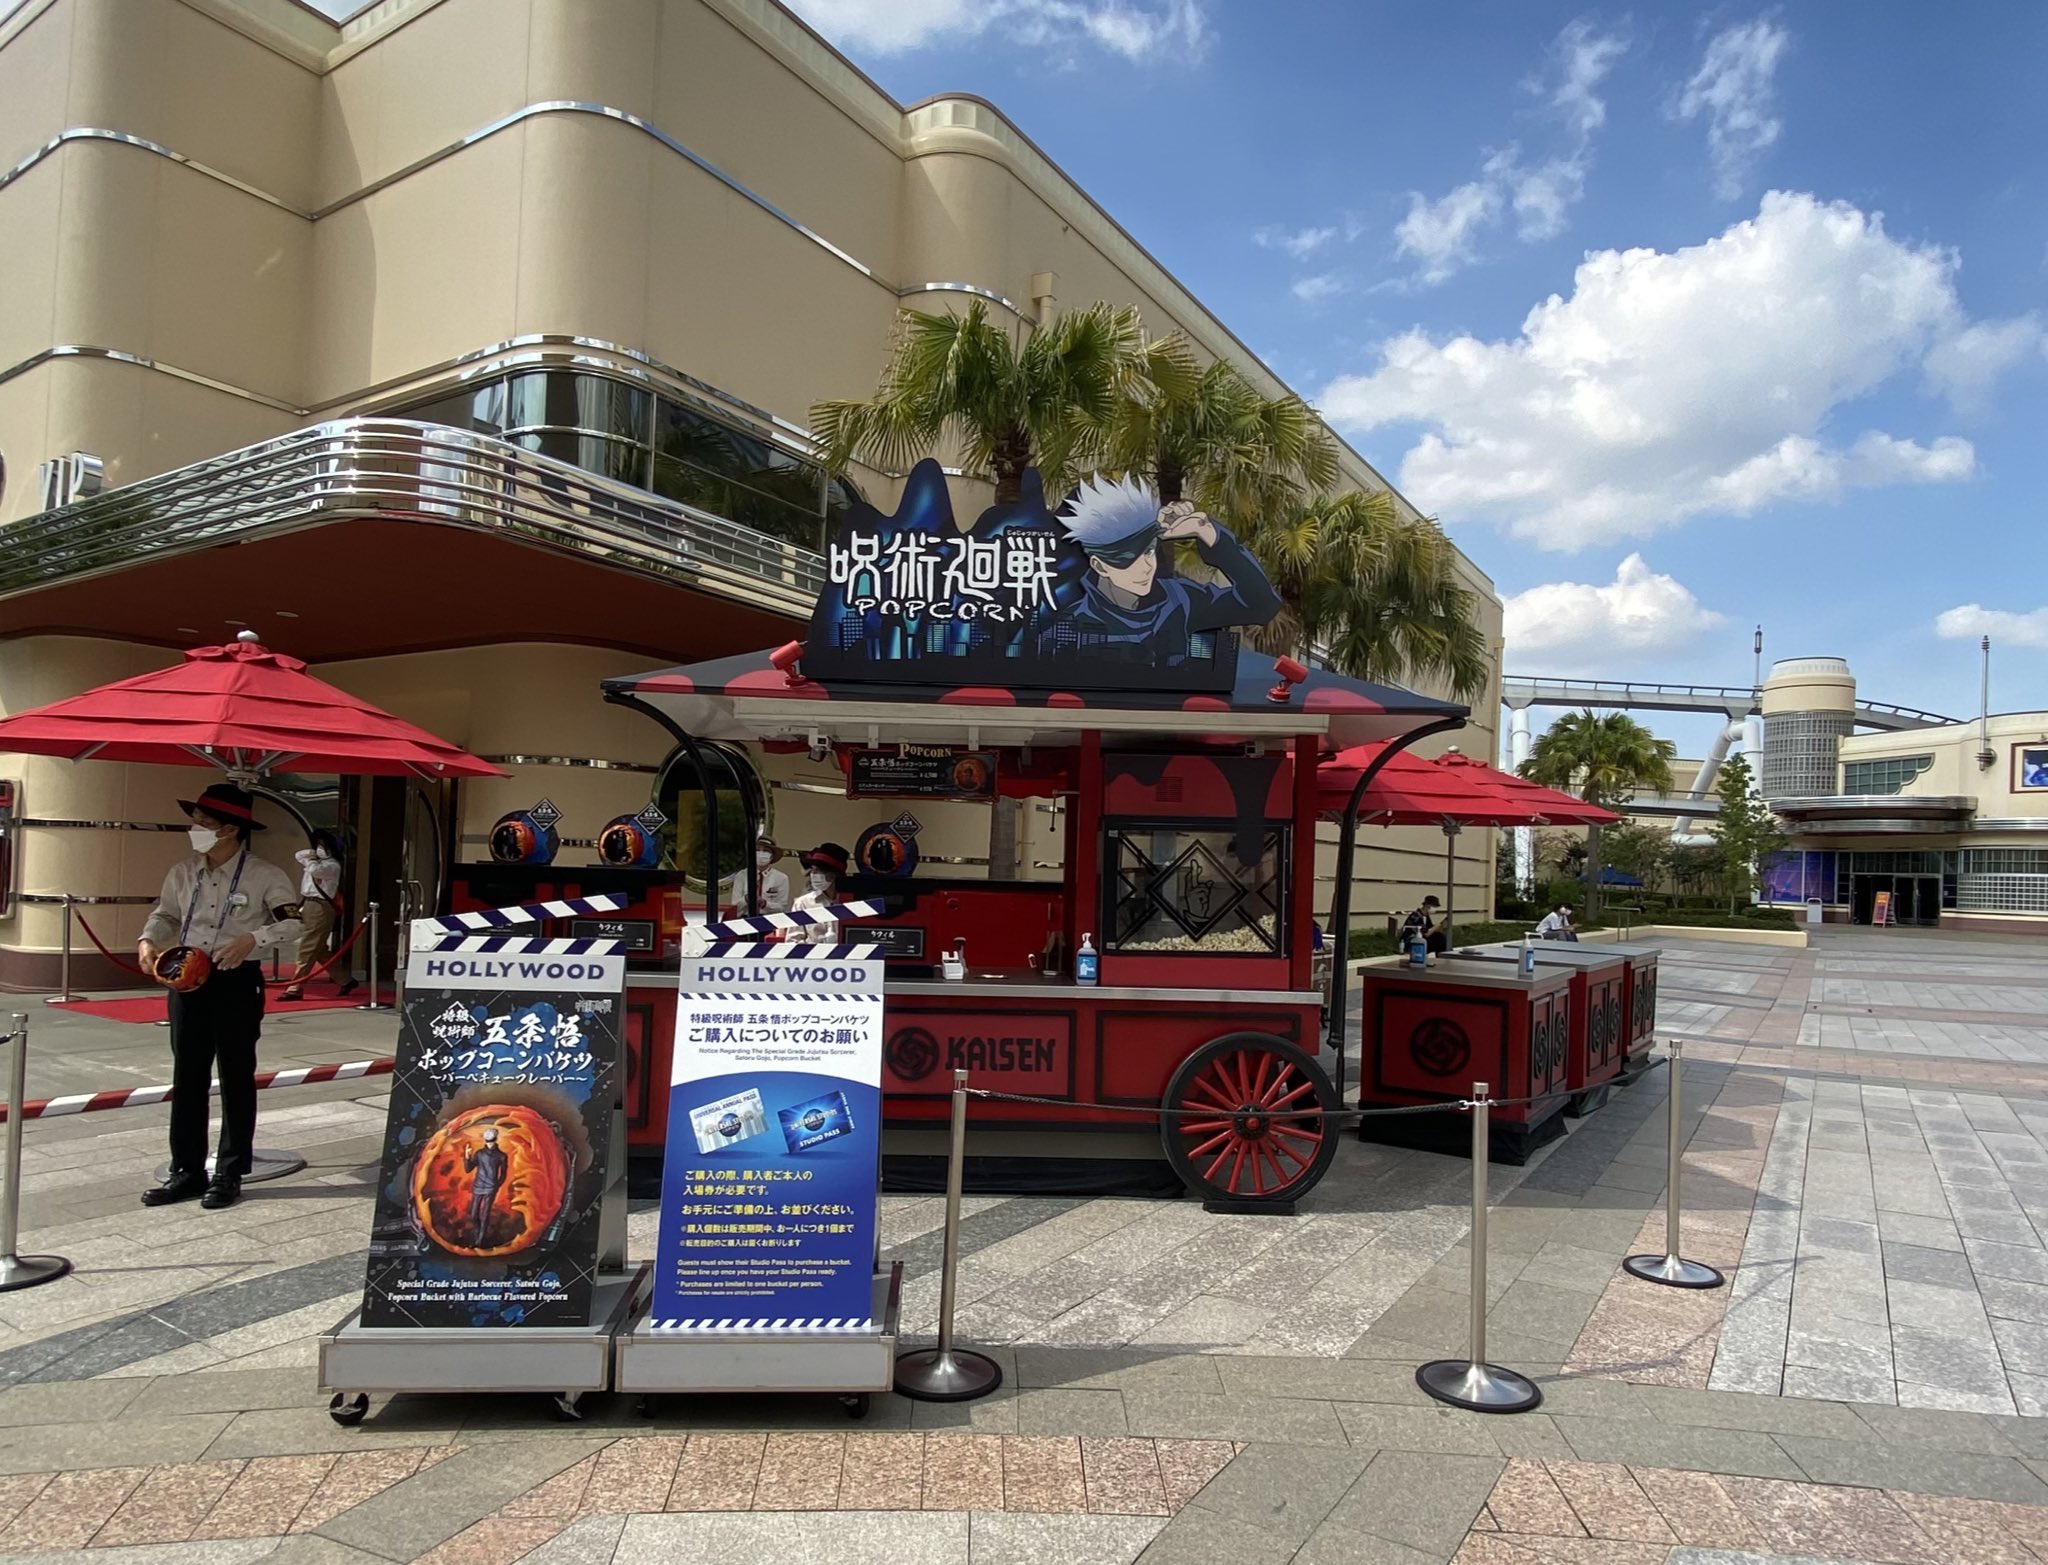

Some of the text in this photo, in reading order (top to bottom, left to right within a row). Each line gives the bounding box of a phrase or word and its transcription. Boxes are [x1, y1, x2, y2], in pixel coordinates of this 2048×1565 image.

[830, 530, 1058, 611] 呪術廻戦
[855, 600, 1029, 622] POPCORN
[426, 960, 605, 980] HOLLYWOOD
[698, 966, 867, 983] HOLLYWOOD
[690, 1013, 744, 1025] 特級呪術師
[479, 1013, 584, 1049] 五条悟
[689, 1027, 869, 1045] ご購入についてのお願い
[418, 1048, 594, 1071] ポップコーンバケツ
[945, 1037, 1056, 1073] KAISEN
[800, 1127, 841, 1148] STUDIO PASS
[795, 1259, 823, 1267] purchase
[397, 1280, 424, 1290] Special
[426, 1280, 450, 1288] Grade
[451, 1280, 479, 1290] Jujutsu
[515, 1280, 540, 1288] Satoru
[388, 1292, 568, 1303] Popcorn Bucket with Barbecue Flavored Popcorn
